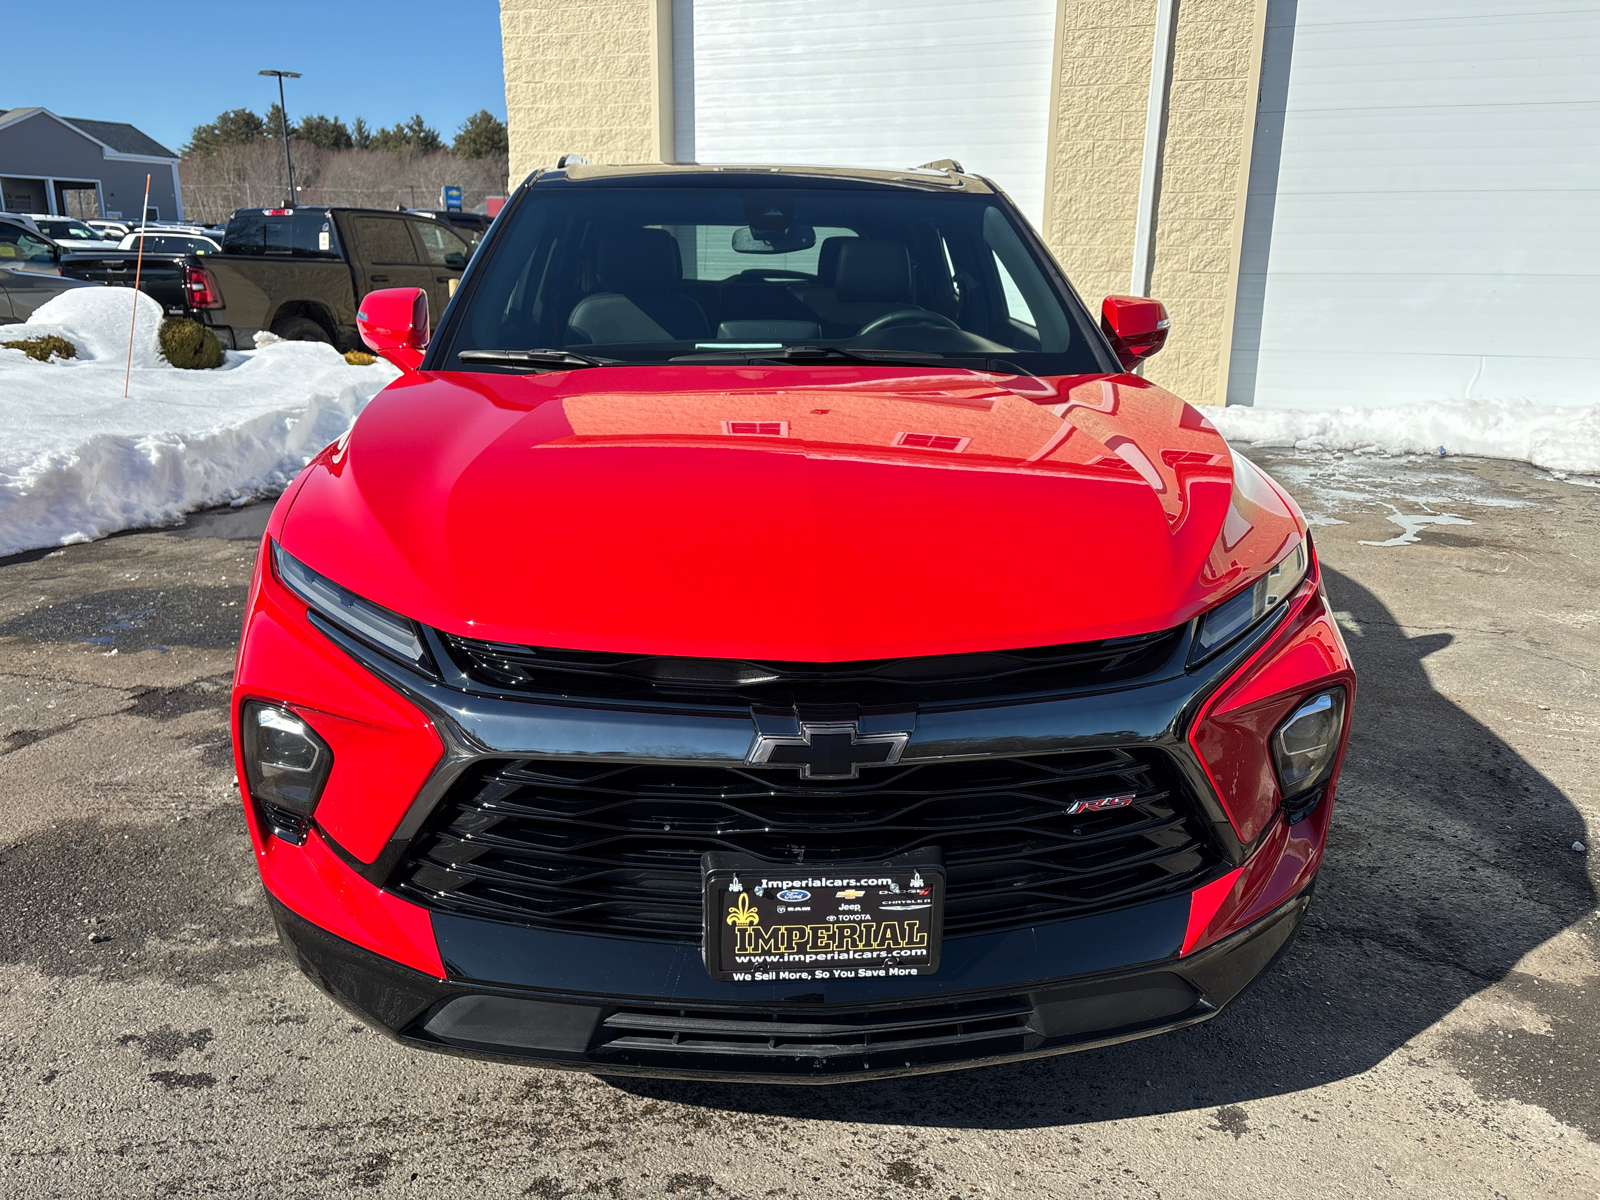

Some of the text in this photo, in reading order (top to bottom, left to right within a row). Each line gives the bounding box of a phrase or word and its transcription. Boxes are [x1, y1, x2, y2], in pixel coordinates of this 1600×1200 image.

[1063, 794, 1137, 815] RS
[761, 877, 892, 890] Imperialcars.com
[783, 892, 803, 900] Ford
[838, 903, 861, 912] Jeep
[838, 914, 871, 922] TOYOTA
[736, 920, 928, 953] IMPERIAL
[735, 948, 927, 963] www.imperialcars.com
[732, 966, 918, 981] We Sell More, So You Save More
